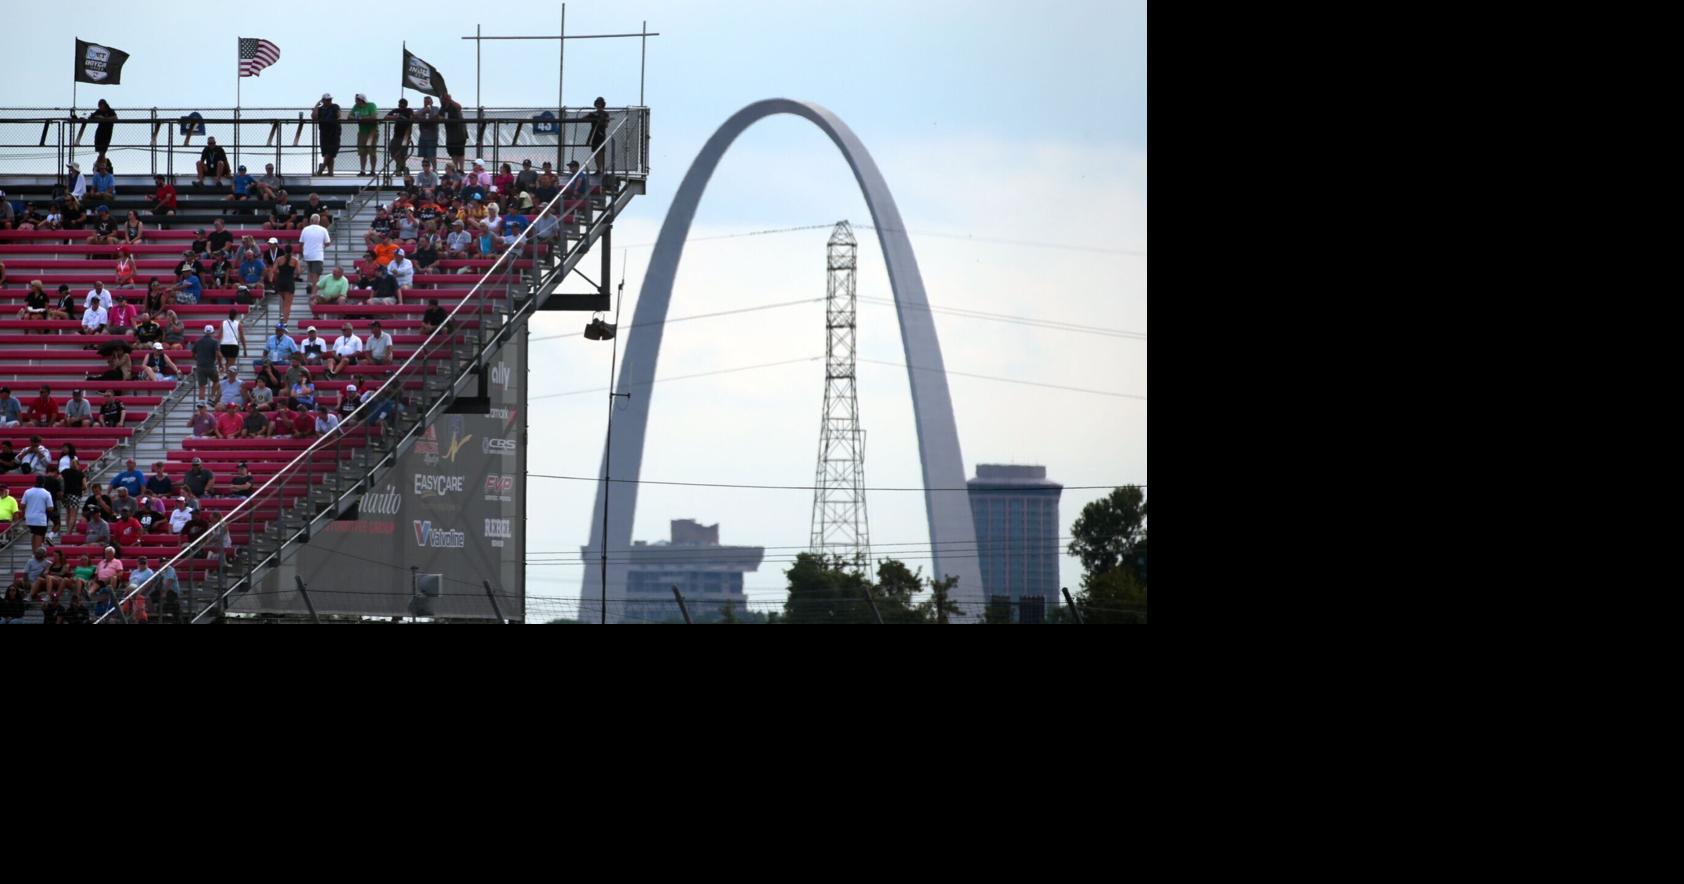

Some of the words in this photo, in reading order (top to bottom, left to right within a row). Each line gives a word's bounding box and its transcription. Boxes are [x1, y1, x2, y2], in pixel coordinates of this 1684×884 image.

[491, 361, 511, 391] ally
[429, 528, 465, 548] Valvoline
[484, 518, 512, 538] REBEL
